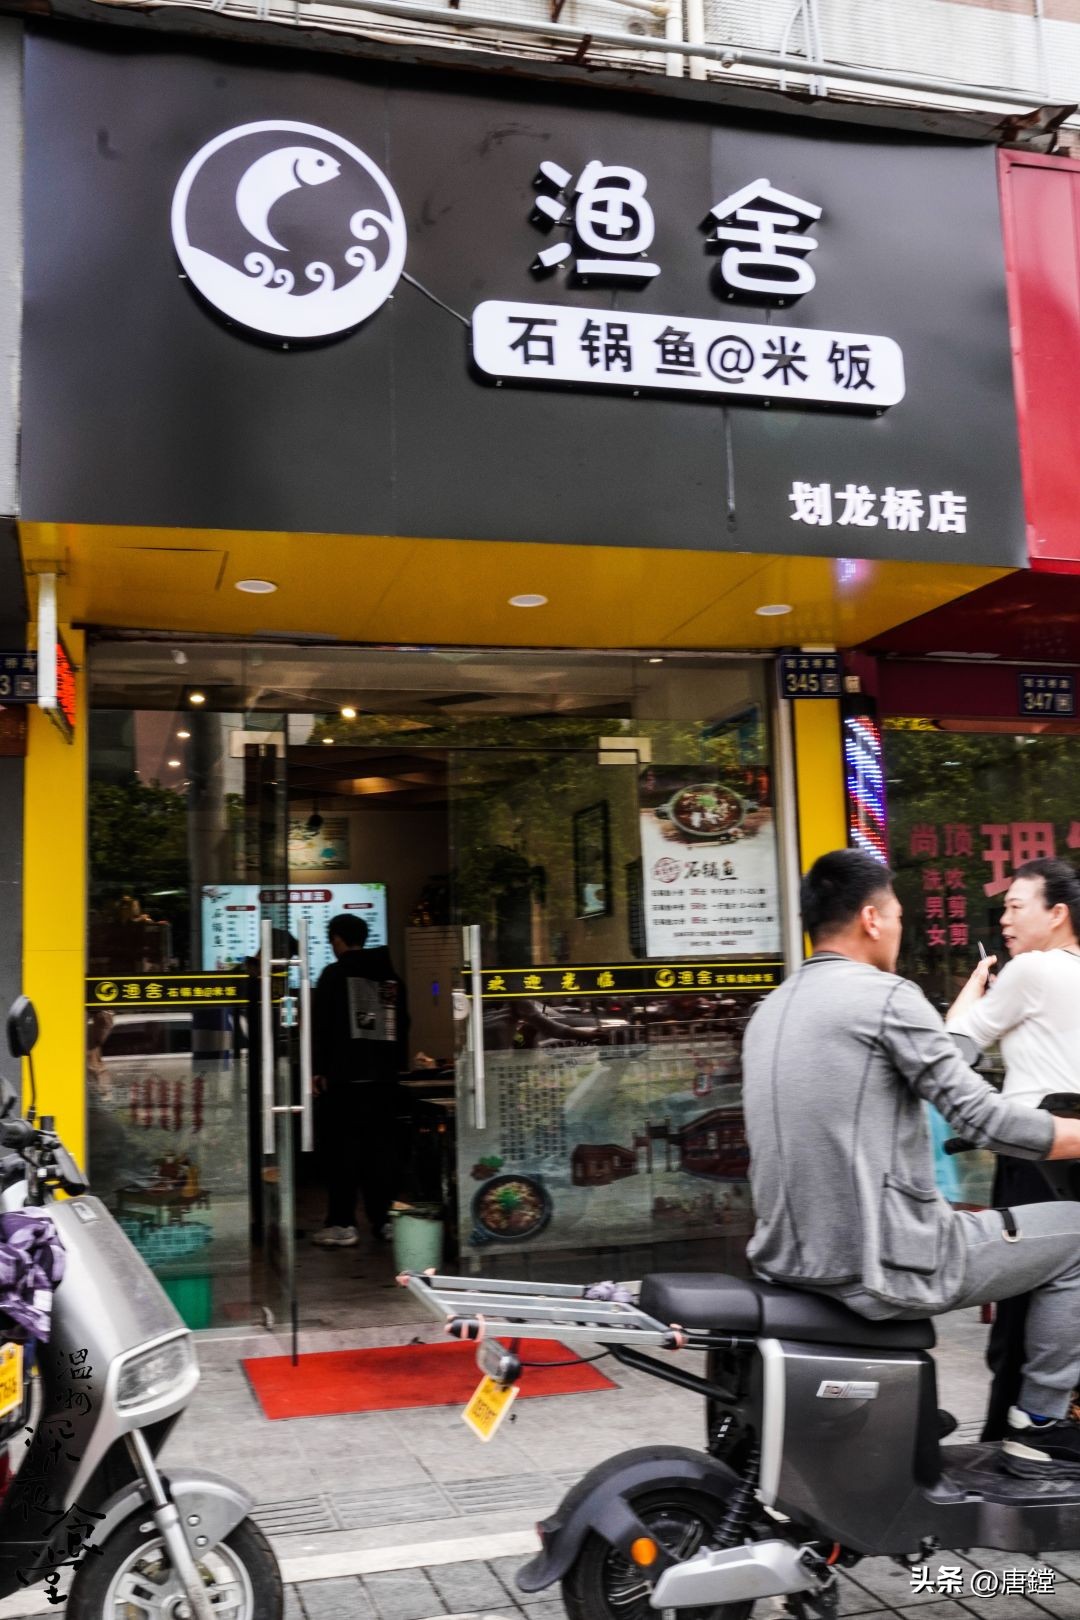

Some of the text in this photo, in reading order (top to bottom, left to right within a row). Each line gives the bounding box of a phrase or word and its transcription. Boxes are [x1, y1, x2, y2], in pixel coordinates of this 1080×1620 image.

[535, 160, 823, 295] 渔舍
[507, 315, 876, 392] 石锅鱼@米饭
[788, 481, 967, 534] 划龙桥店
[786, 673, 819, 692] 345
[1024, 692, 1054, 710] 347
[910, 822, 974, 857] 尚顶
[487, 971, 615, 991] 欢迎光临
